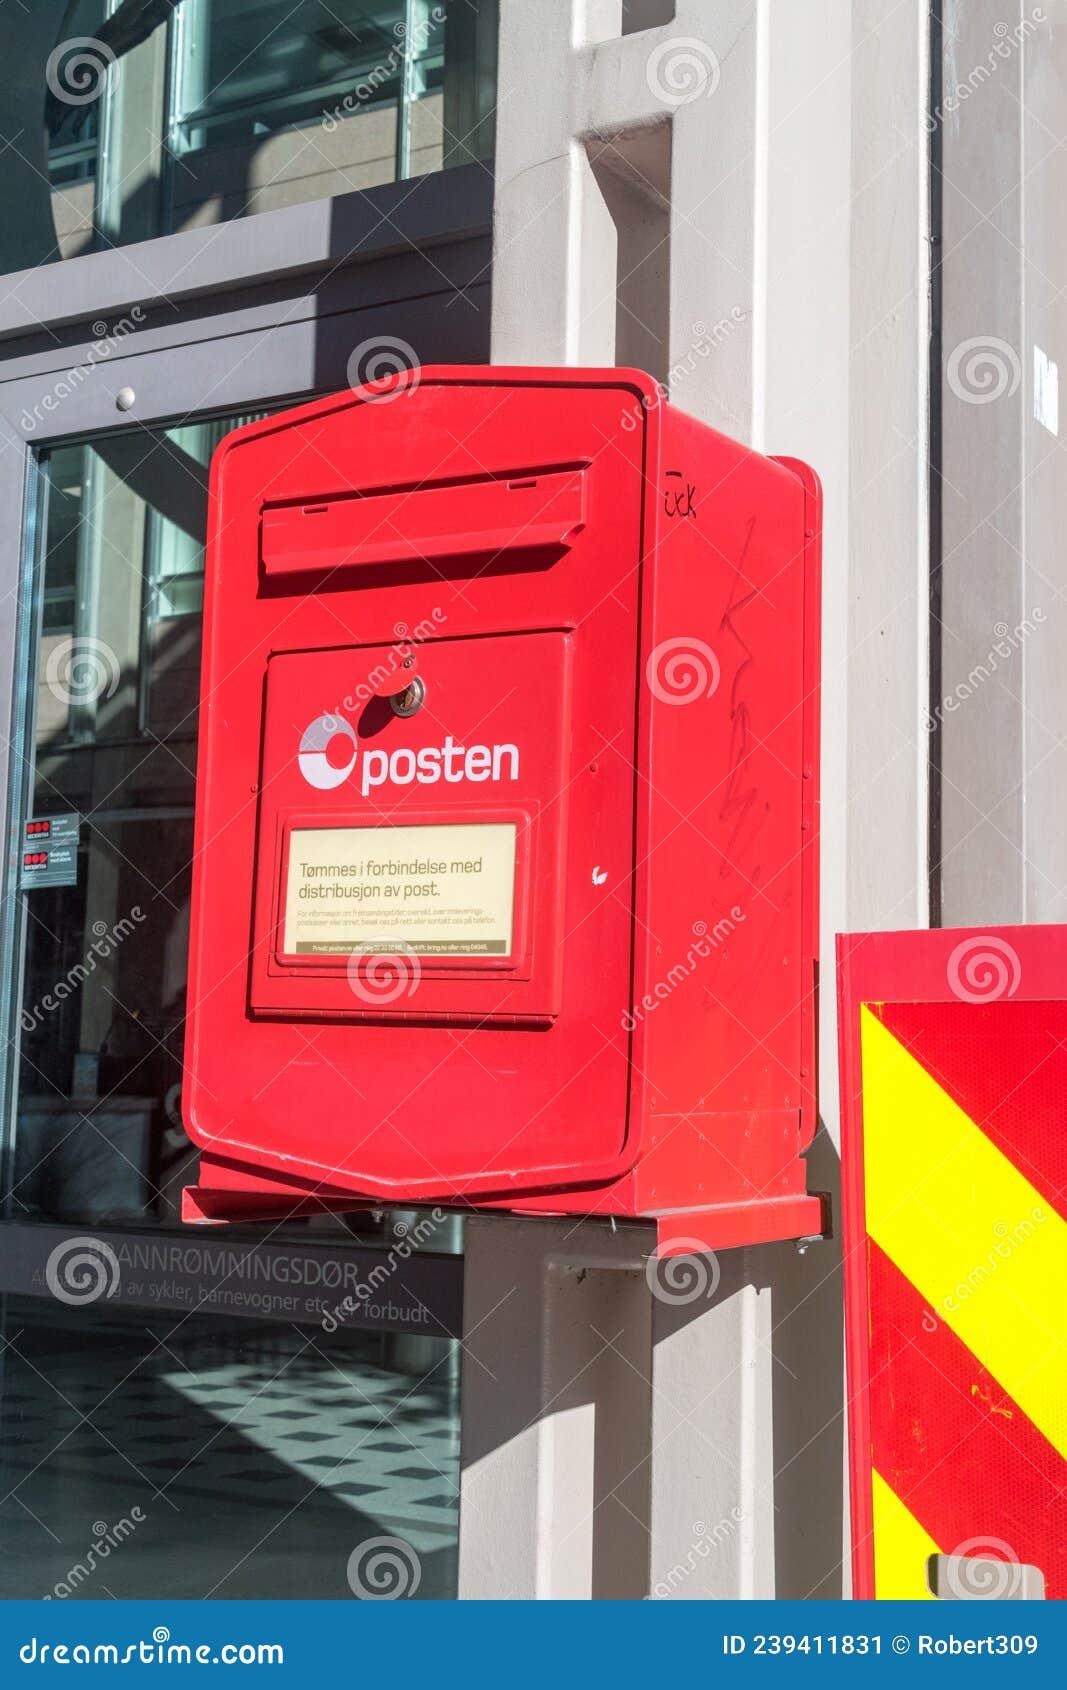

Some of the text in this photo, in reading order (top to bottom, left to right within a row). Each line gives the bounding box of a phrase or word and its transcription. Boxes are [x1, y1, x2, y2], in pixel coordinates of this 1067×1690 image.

[361, 736, 520, 797] posten
[300, 857, 483, 878] Tømmes i forbindelse med
[298, 881, 442, 902] distribusjon av post.
[127, 1283, 145, 1297] av
[148, 1279, 193, 1303] sykler,
[199, 1281, 298, 1313] barnevogner
[362, 1298, 430, 1324] forbudt
